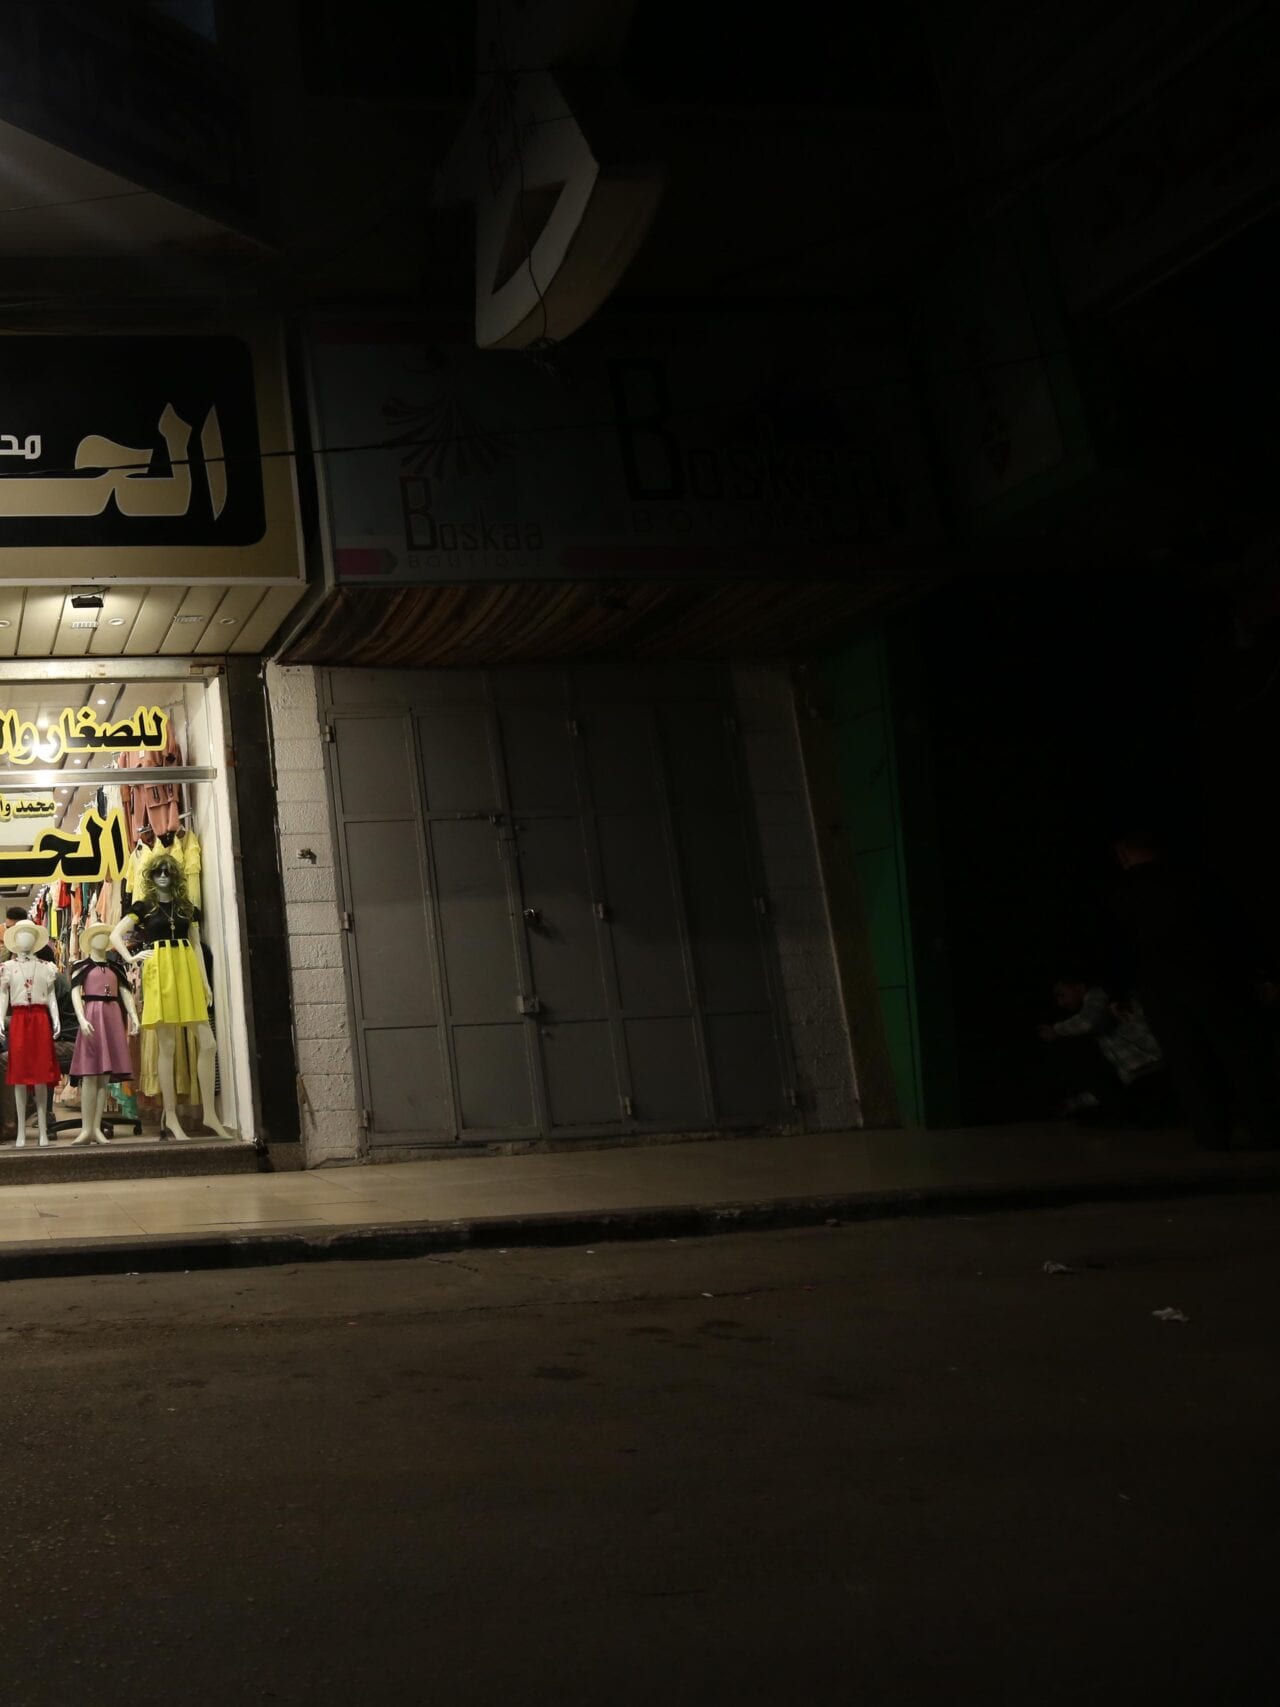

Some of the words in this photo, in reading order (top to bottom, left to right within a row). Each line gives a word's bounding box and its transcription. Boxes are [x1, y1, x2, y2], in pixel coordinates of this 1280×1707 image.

[400, 476, 544, 553] Boskaa
[57, 704, 164, 762] للصغار
[16, 799, 55, 813] محمد
